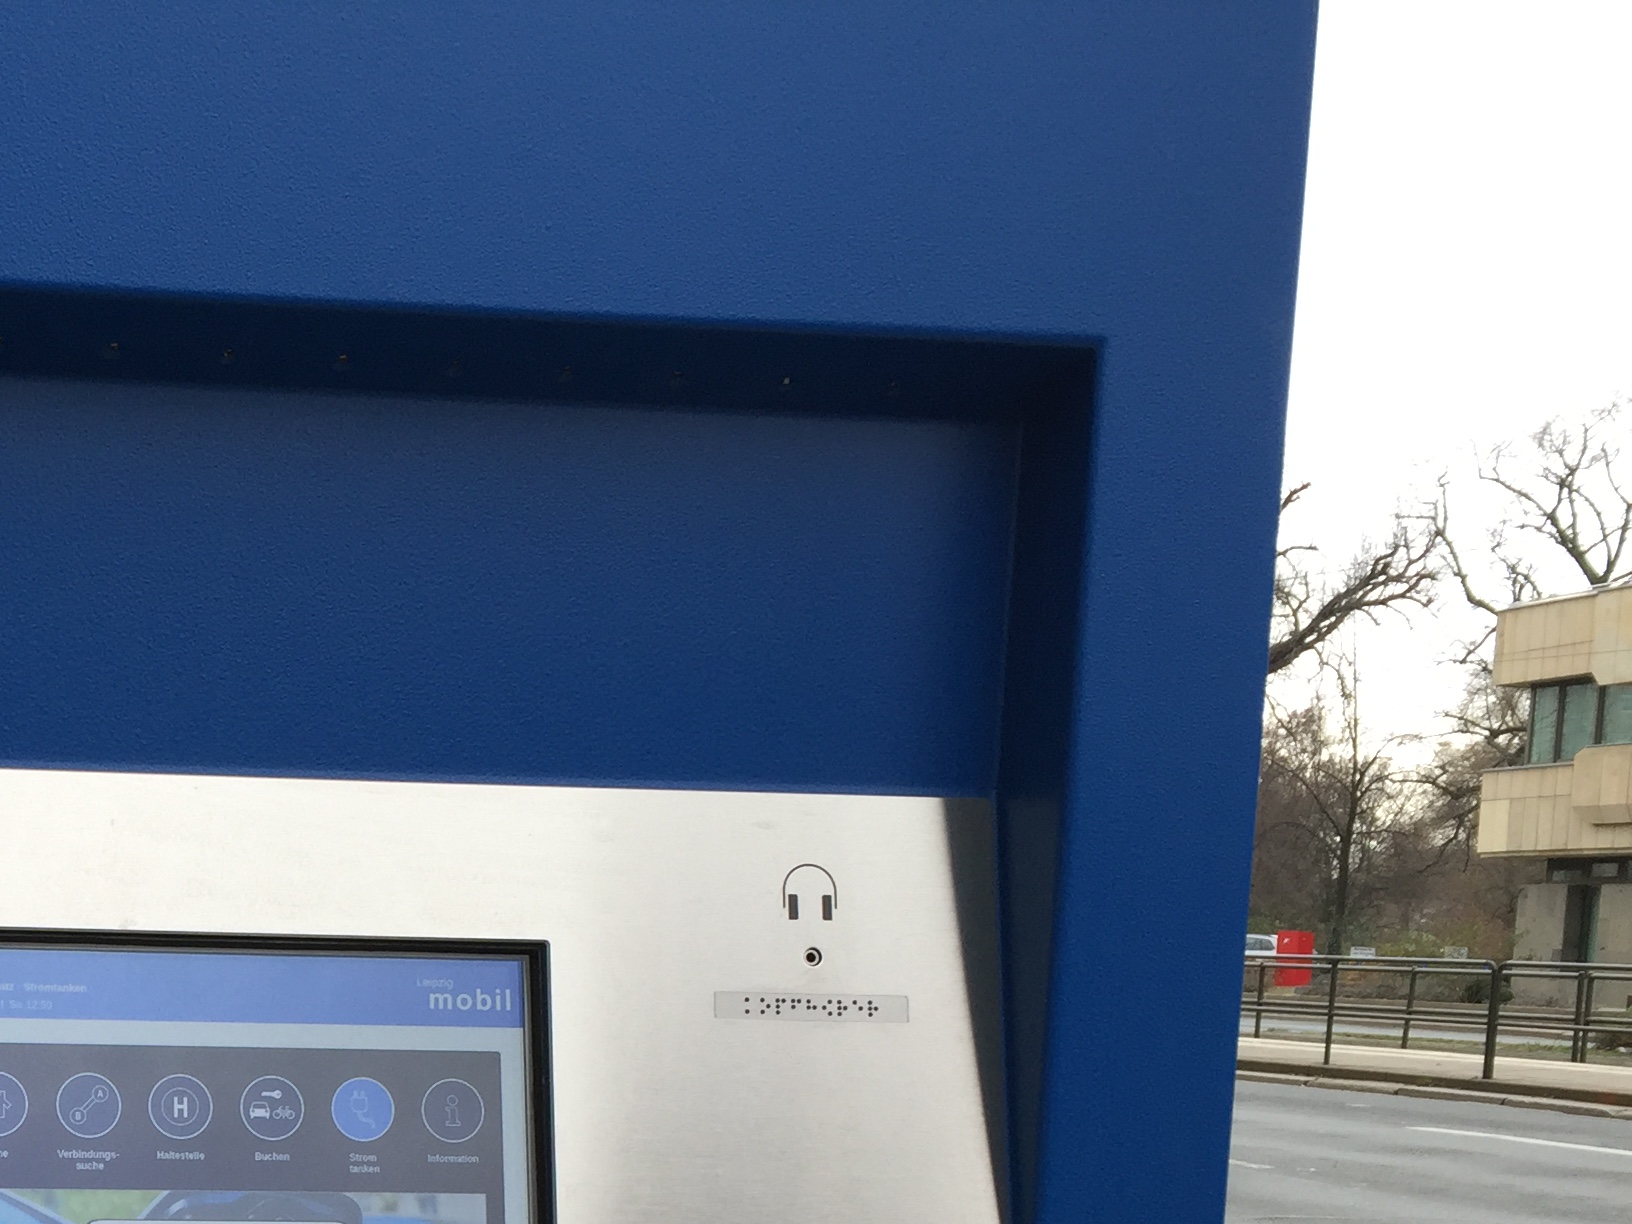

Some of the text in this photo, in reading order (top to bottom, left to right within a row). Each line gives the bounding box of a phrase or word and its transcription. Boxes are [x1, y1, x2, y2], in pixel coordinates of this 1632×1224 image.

[23, 982, 87, 993] Stromtanken
[416, 977, 454, 990] Leipzig
[429, 988, 512, 1011] mobil
[57, 1149, 120, 1162] Verbindungs-
[156, 1151, 205, 1161] Haltestelle
[254, 1152, 290, 1161] Buchen
[349, 1153, 377, 1163] Strom
[427, 1154, 480, 1164] Information
[76, 1161, 104, 1170] suche
[349, 1164, 380, 1174] tanken
